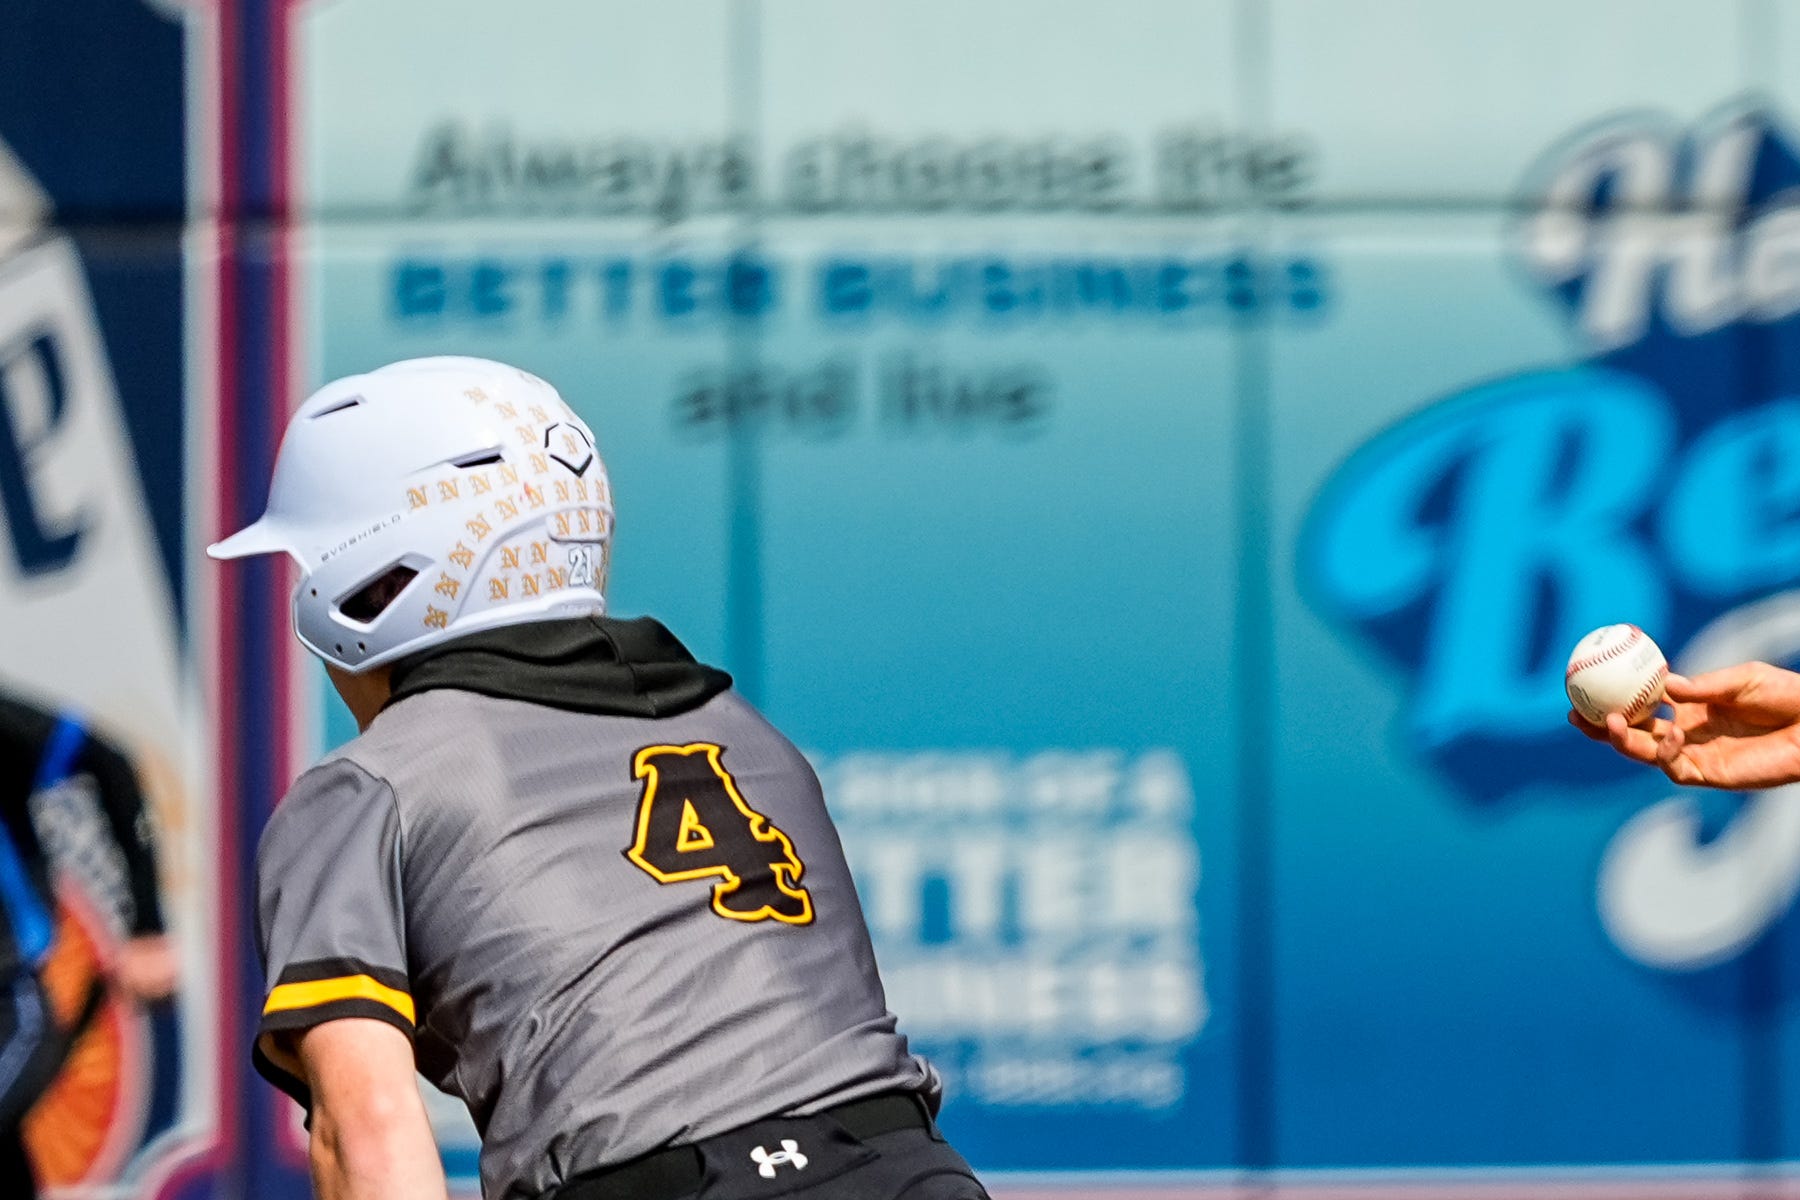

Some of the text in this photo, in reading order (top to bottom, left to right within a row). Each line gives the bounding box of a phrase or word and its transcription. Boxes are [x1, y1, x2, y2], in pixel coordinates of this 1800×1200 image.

[410, 122, 1318, 228] Always choose the
[384, 250, 1334, 323] BETTER BUSINESS
[675, 355, 1050, 433] and live
[568, 545, 593, 587] 21
[622, 741, 816, 926] 4
